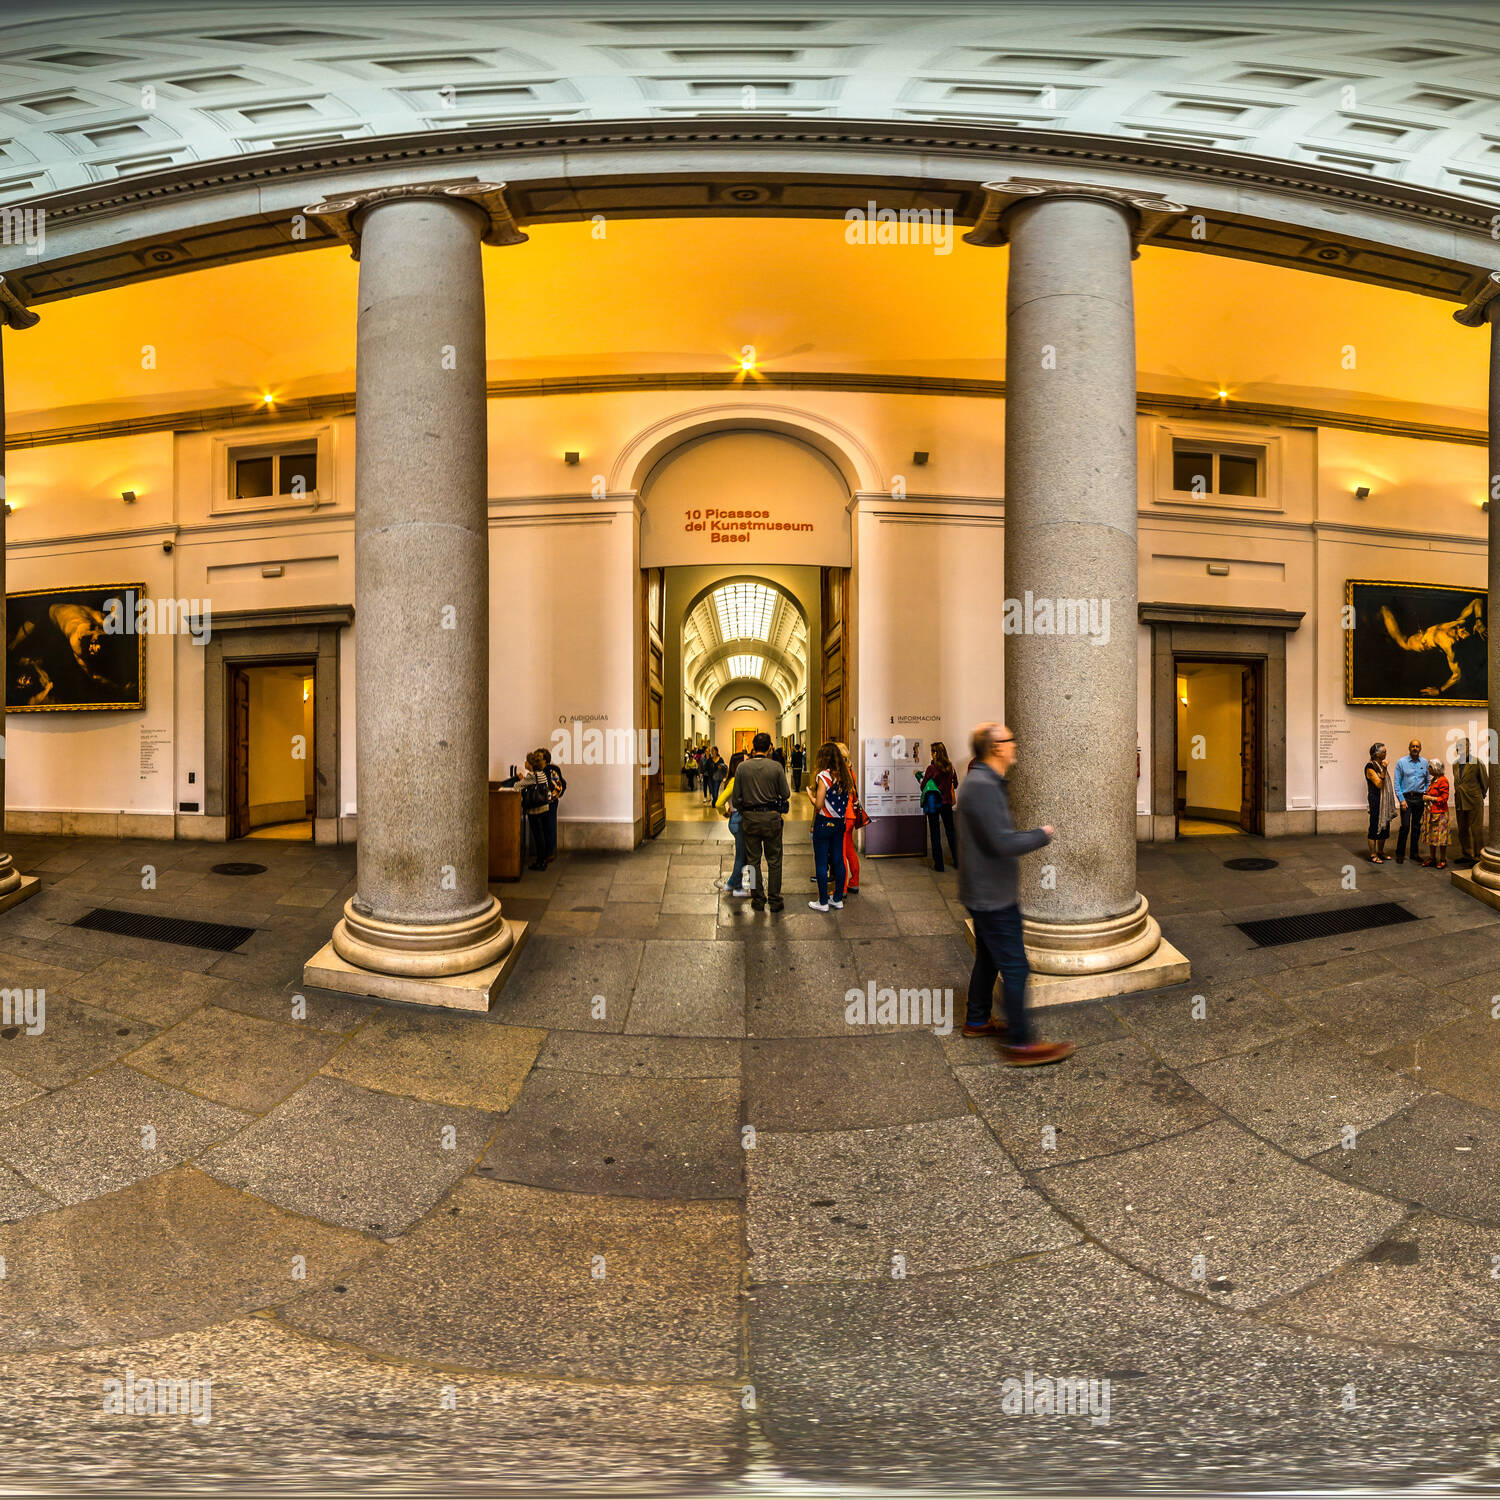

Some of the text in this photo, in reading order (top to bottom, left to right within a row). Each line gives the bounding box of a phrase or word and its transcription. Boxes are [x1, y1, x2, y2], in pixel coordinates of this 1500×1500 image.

[685, 509, 770, 520] 10 Picassos
[685, 520, 814, 532] del Kunstmuseum
[711, 532, 750, 543] Basel
